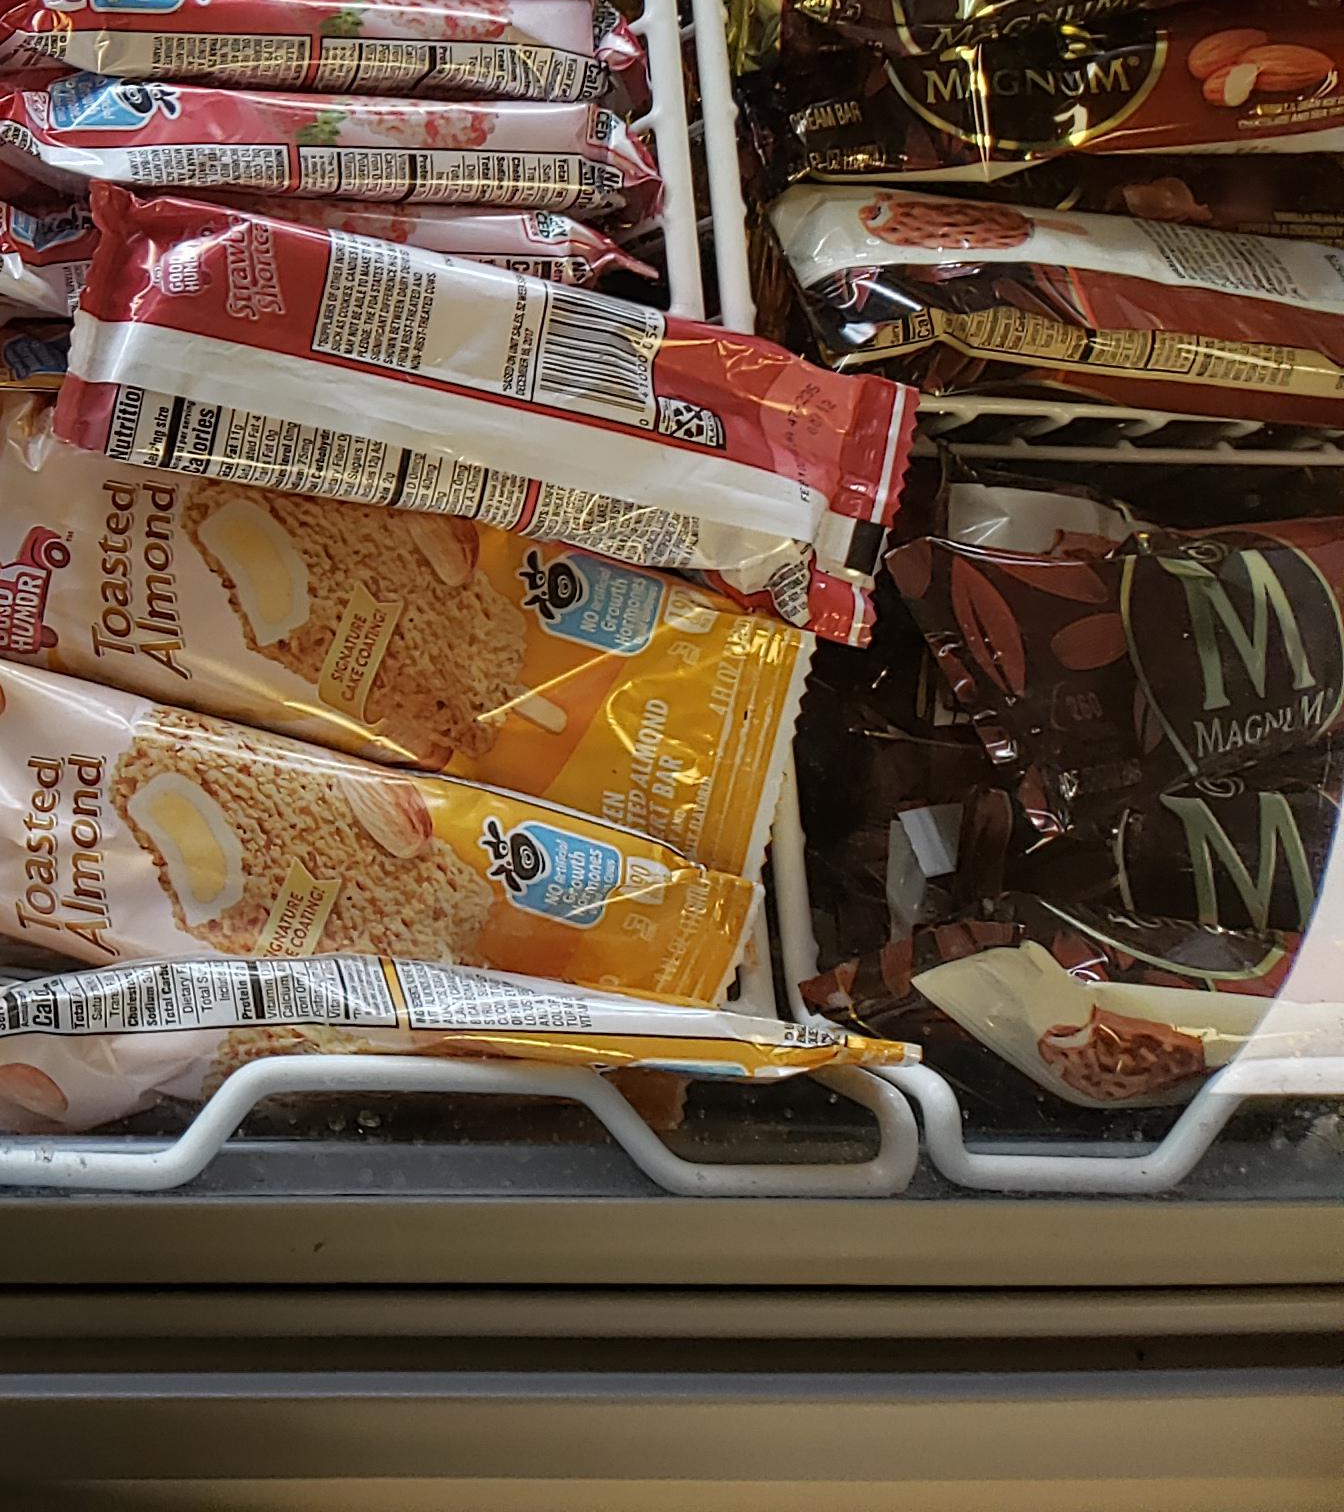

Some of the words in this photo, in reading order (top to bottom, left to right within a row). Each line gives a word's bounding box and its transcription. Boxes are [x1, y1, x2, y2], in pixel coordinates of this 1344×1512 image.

[834, 101, 861, 125] BAR
[152, 404, 170, 429] size
[181, 399, 198, 430] serving
[183, 406, 216, 475] Calories
[247, 422, 261, 438] Fat
[265, 428, 280, 443] 0g
[261, 442, 276, 458] Fat
[296, 437, 315, 466] 75mg
[331, 441, 348, 468] Fiber
[346, 445, 366, 481] Sugars
[382, 470, 396, 485] 2g
[92, 481, 138, 659] Toasted
[134, 480, 193, 679] Almond
[11, 573, 44, 652] HUMOR
[580, 611, 598, 633] NO
[603, 576, 631, 633] Growth
[615, 574, 647, 646] Hormones
[1158, 548, 1317, 712] M
[331, 613, 369, 684] SIGNATURE
[342, 665, 361, 702] CAKE
[355, 609, 387, 670] COATING!
[631, 698, 670, 771] ALMOND
[658, 754, 685, 806] BAR
[15, 756, 66, 931] Toasted
[61, 753, 123, 958] Almond
[552, 838, 569, 887] Artificial
[1158, 791, 1316, 931] M
[545, 885, 563, 909] NO
[562, 850, 587, 905] Growth
[290, 885, 325, 942] COATING!
